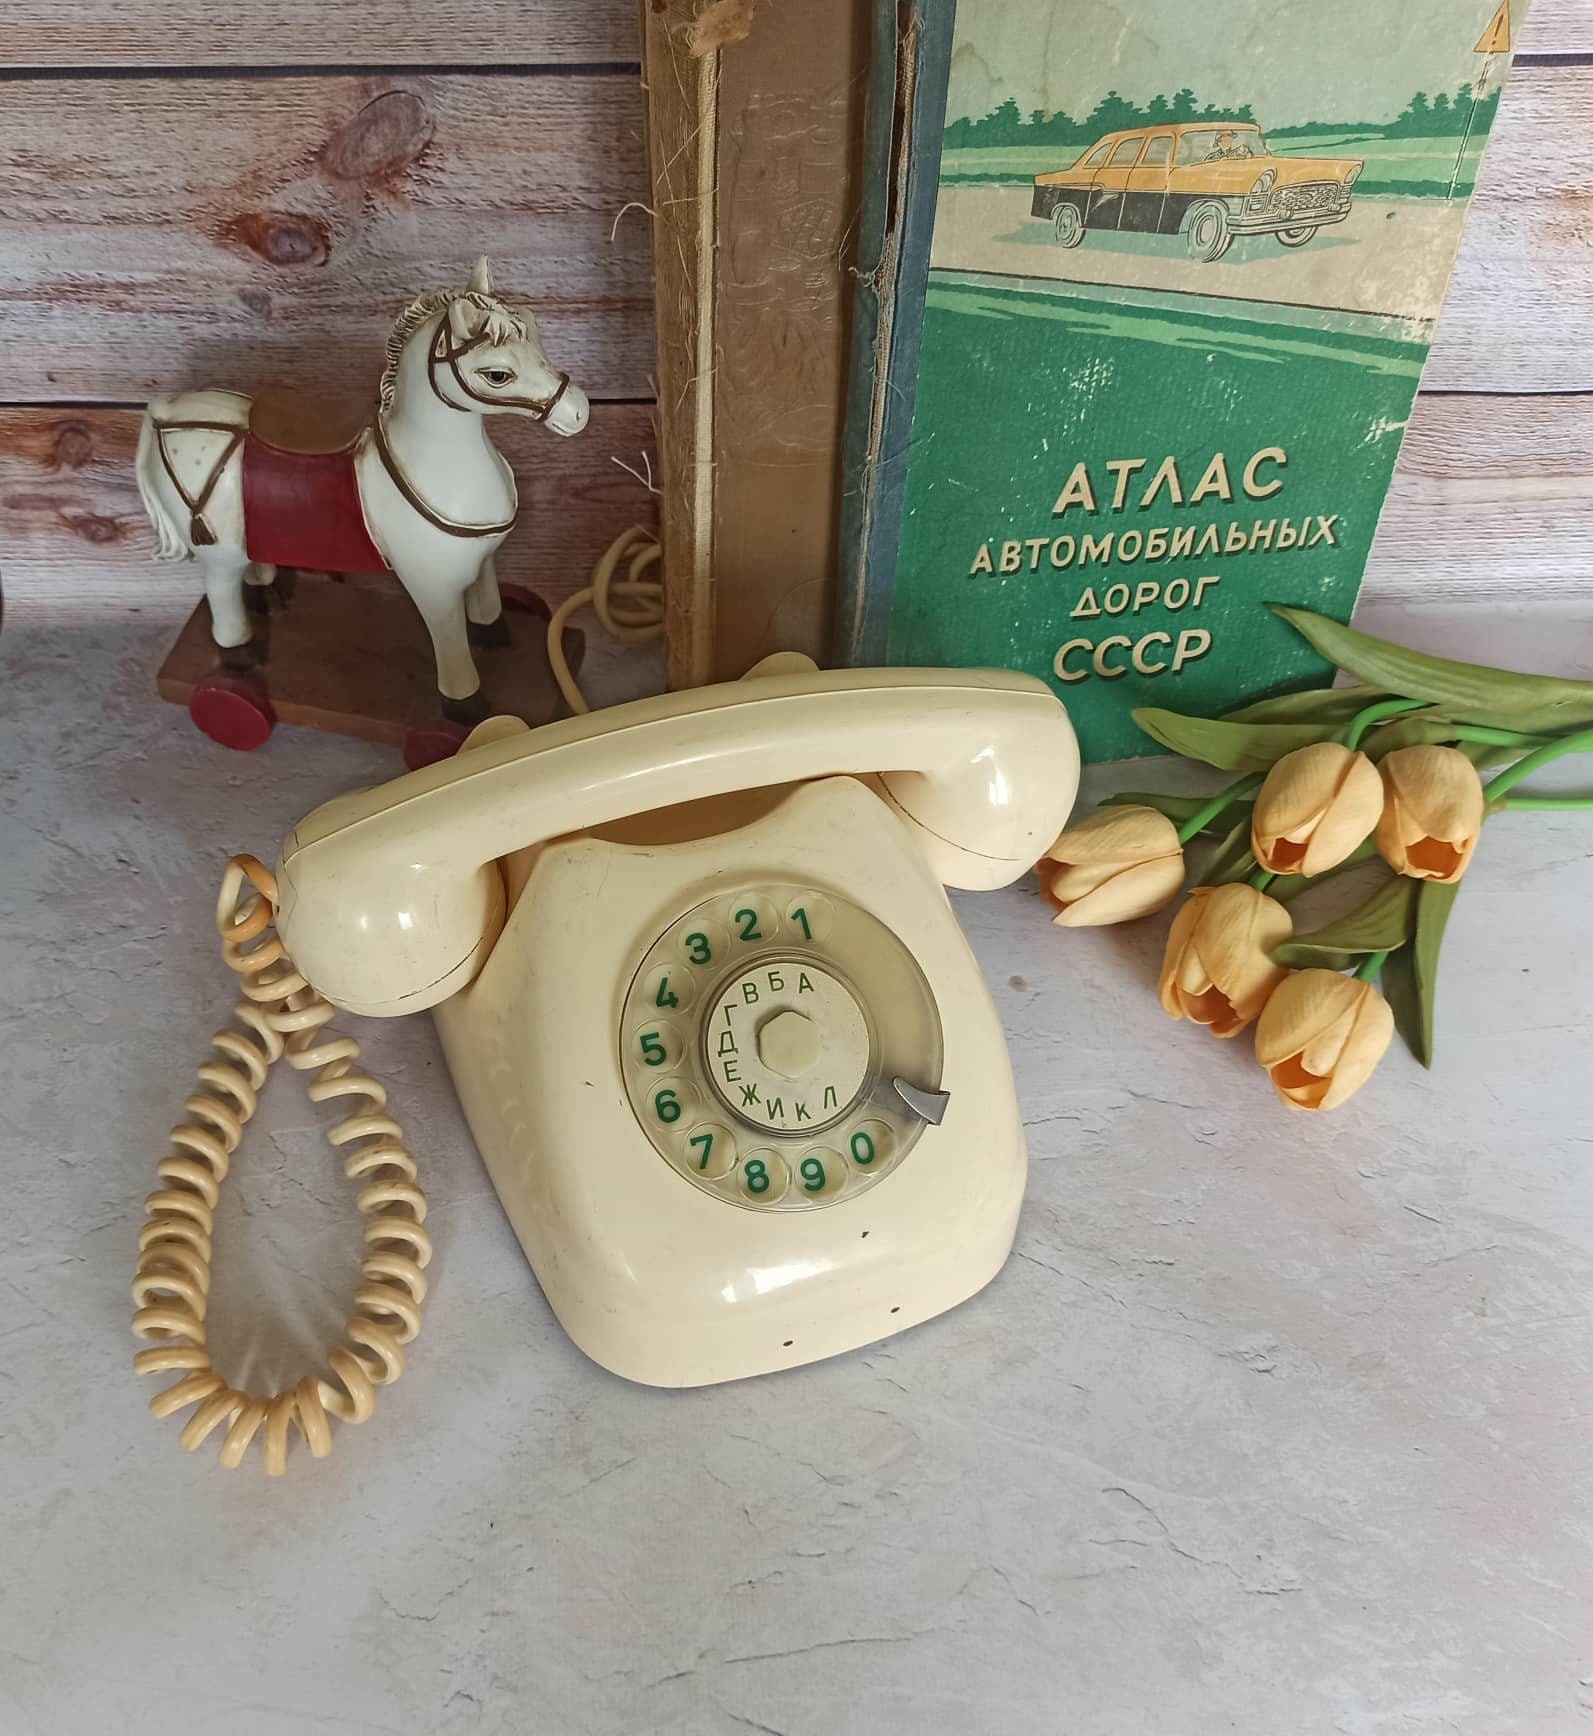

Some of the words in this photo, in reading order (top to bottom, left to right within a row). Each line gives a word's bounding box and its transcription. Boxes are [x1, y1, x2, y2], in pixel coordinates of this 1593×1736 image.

[1052, 447, 1287, 518] АТЛАС
[969, 515, 1340, 577] АВТОМОБИЛЬНЫХ
[1070, 576, 1221, 618] ДОРОГ
[1053, 629, 1213, 683] СССР
[735, 909, 762, 941] 2
[791, 908, 812, 939] 1
[685, 933, 712, 964] 3
[656, 977, 679, 1008] 4
[640, 1032, 666, 1065] 5
[655, 1090, 681, 1123] 6
[690, 1134, 713, 1169] 7
[851, 1132, 874, 1164] 0
[745, 1160, 769, 1193] 8
[800, 1158, 826, 1191] 9
